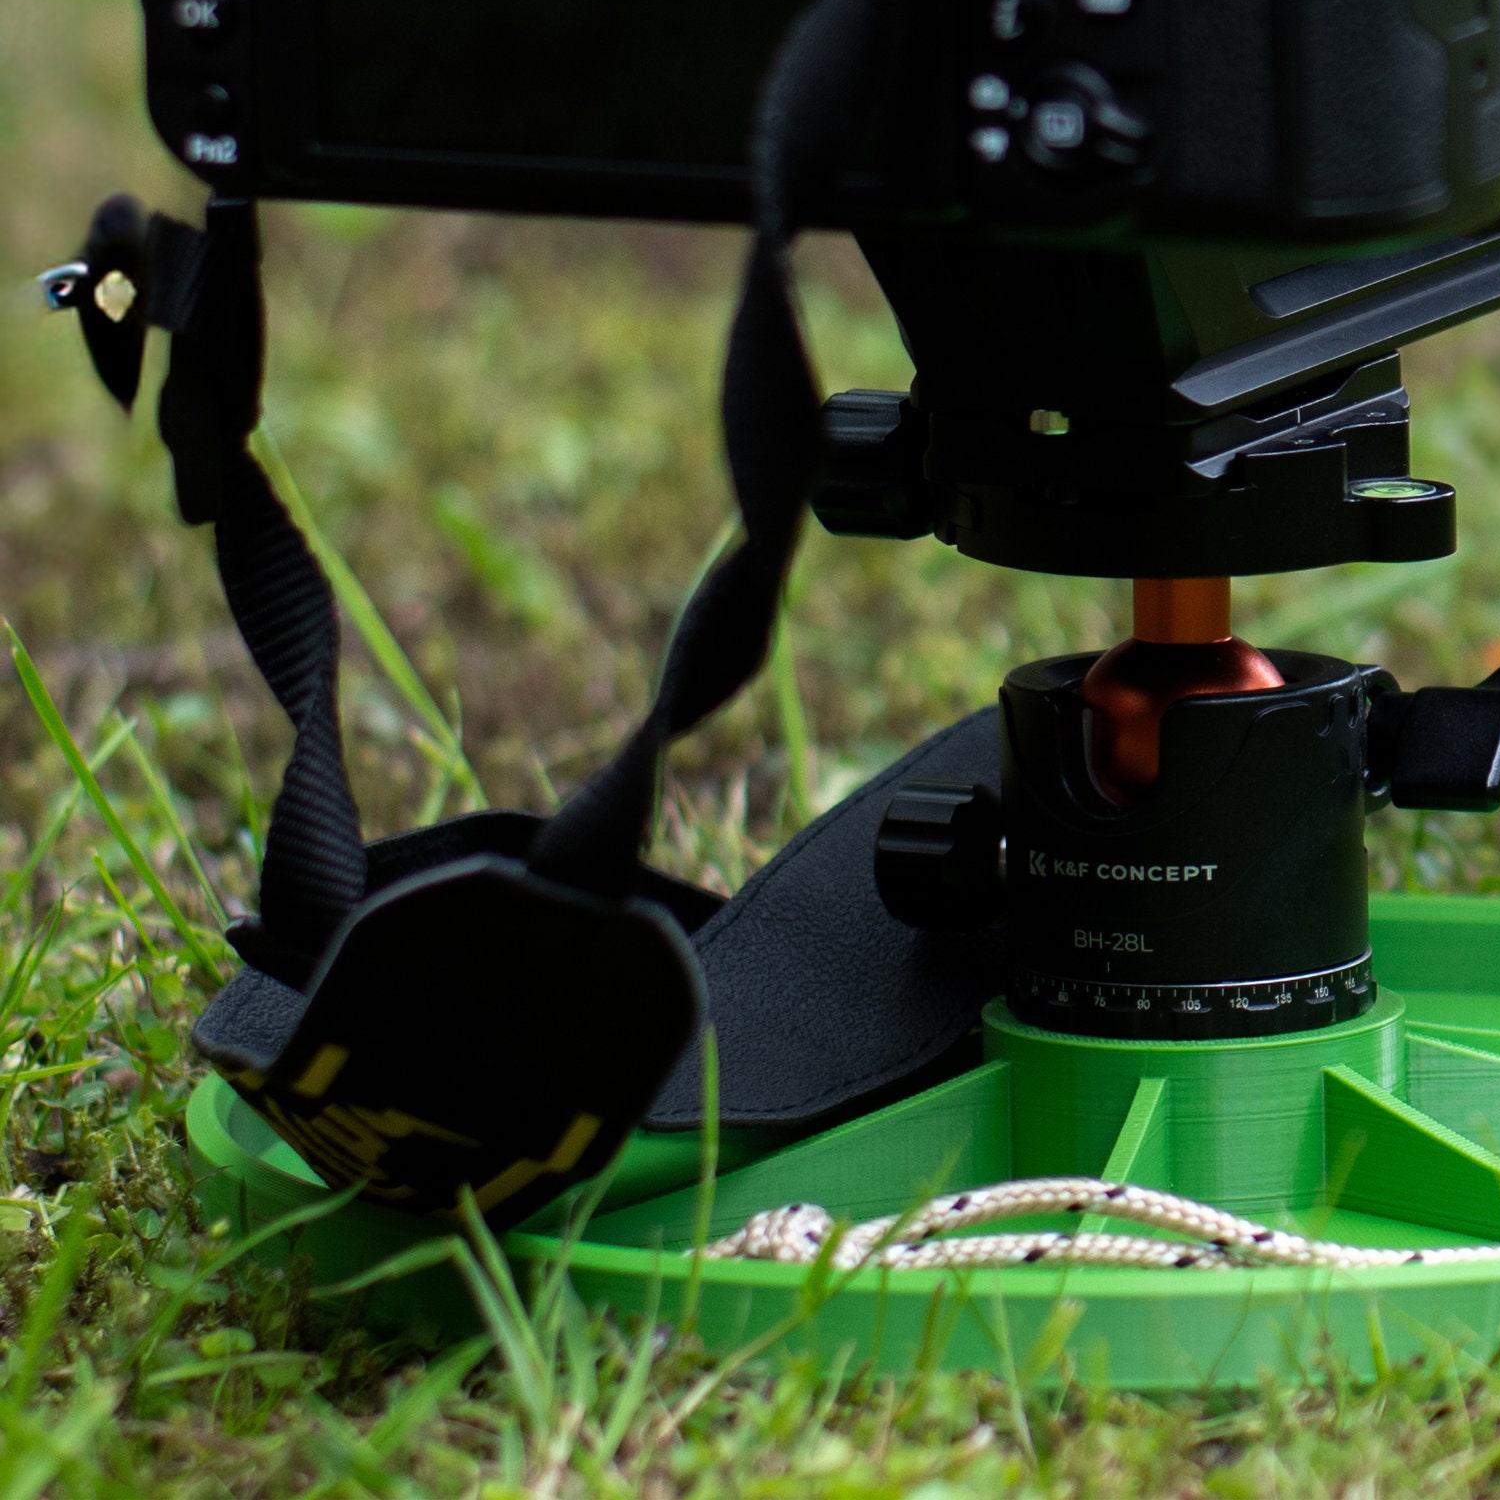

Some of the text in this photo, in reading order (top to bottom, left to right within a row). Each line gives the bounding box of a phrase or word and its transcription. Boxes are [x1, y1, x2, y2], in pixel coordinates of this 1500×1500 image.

[1054, 860, 1218, 882] K&F CONCEPT
[1074, 930, 1153, 952] BH-28L
[1093, 996, 1106, 1007] 75
[1137, 998, 1150, 1010] 90
[1181, 999, 1200, 1011] 105
[1229, 997, 1248, 1008] 120
[1274, 992, 1292, 1004] 135
[1314, 986, 1329, 998] 150
